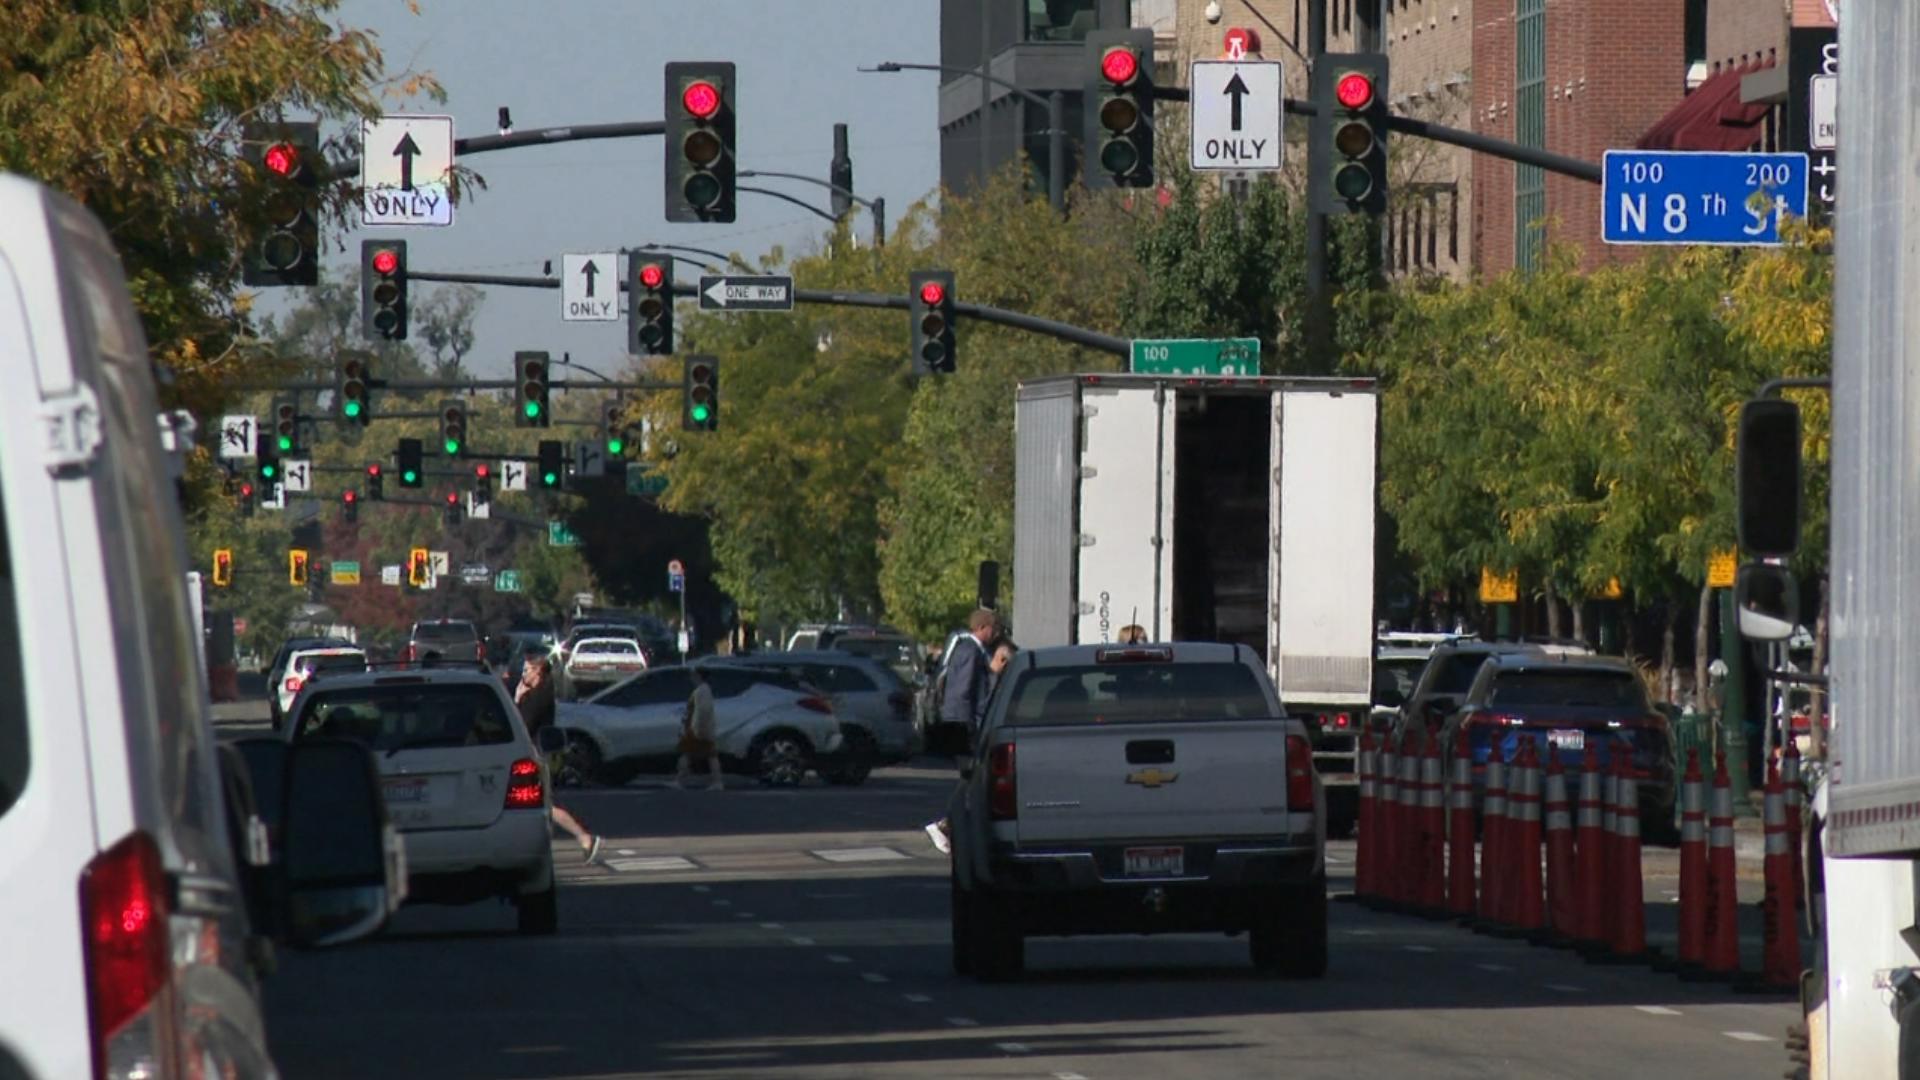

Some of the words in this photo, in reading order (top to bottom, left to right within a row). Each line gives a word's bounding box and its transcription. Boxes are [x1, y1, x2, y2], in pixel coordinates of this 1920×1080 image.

[1206, 138, 1267, 160] ONLY
[1621, 162, 1664, 184] 100
[1745, 163, 1791, 185] 200
[375, 196, 440, 216] ONLY
[1620, 193, 1647, 233] N
[1742, 193, 1790, 236] St
[726, 286, 750, 299] ONE
[757, 286, 783, 299] WAY
[569, 302, 612, 317] ONLY
[1143, 346, 1169, 361] 100
